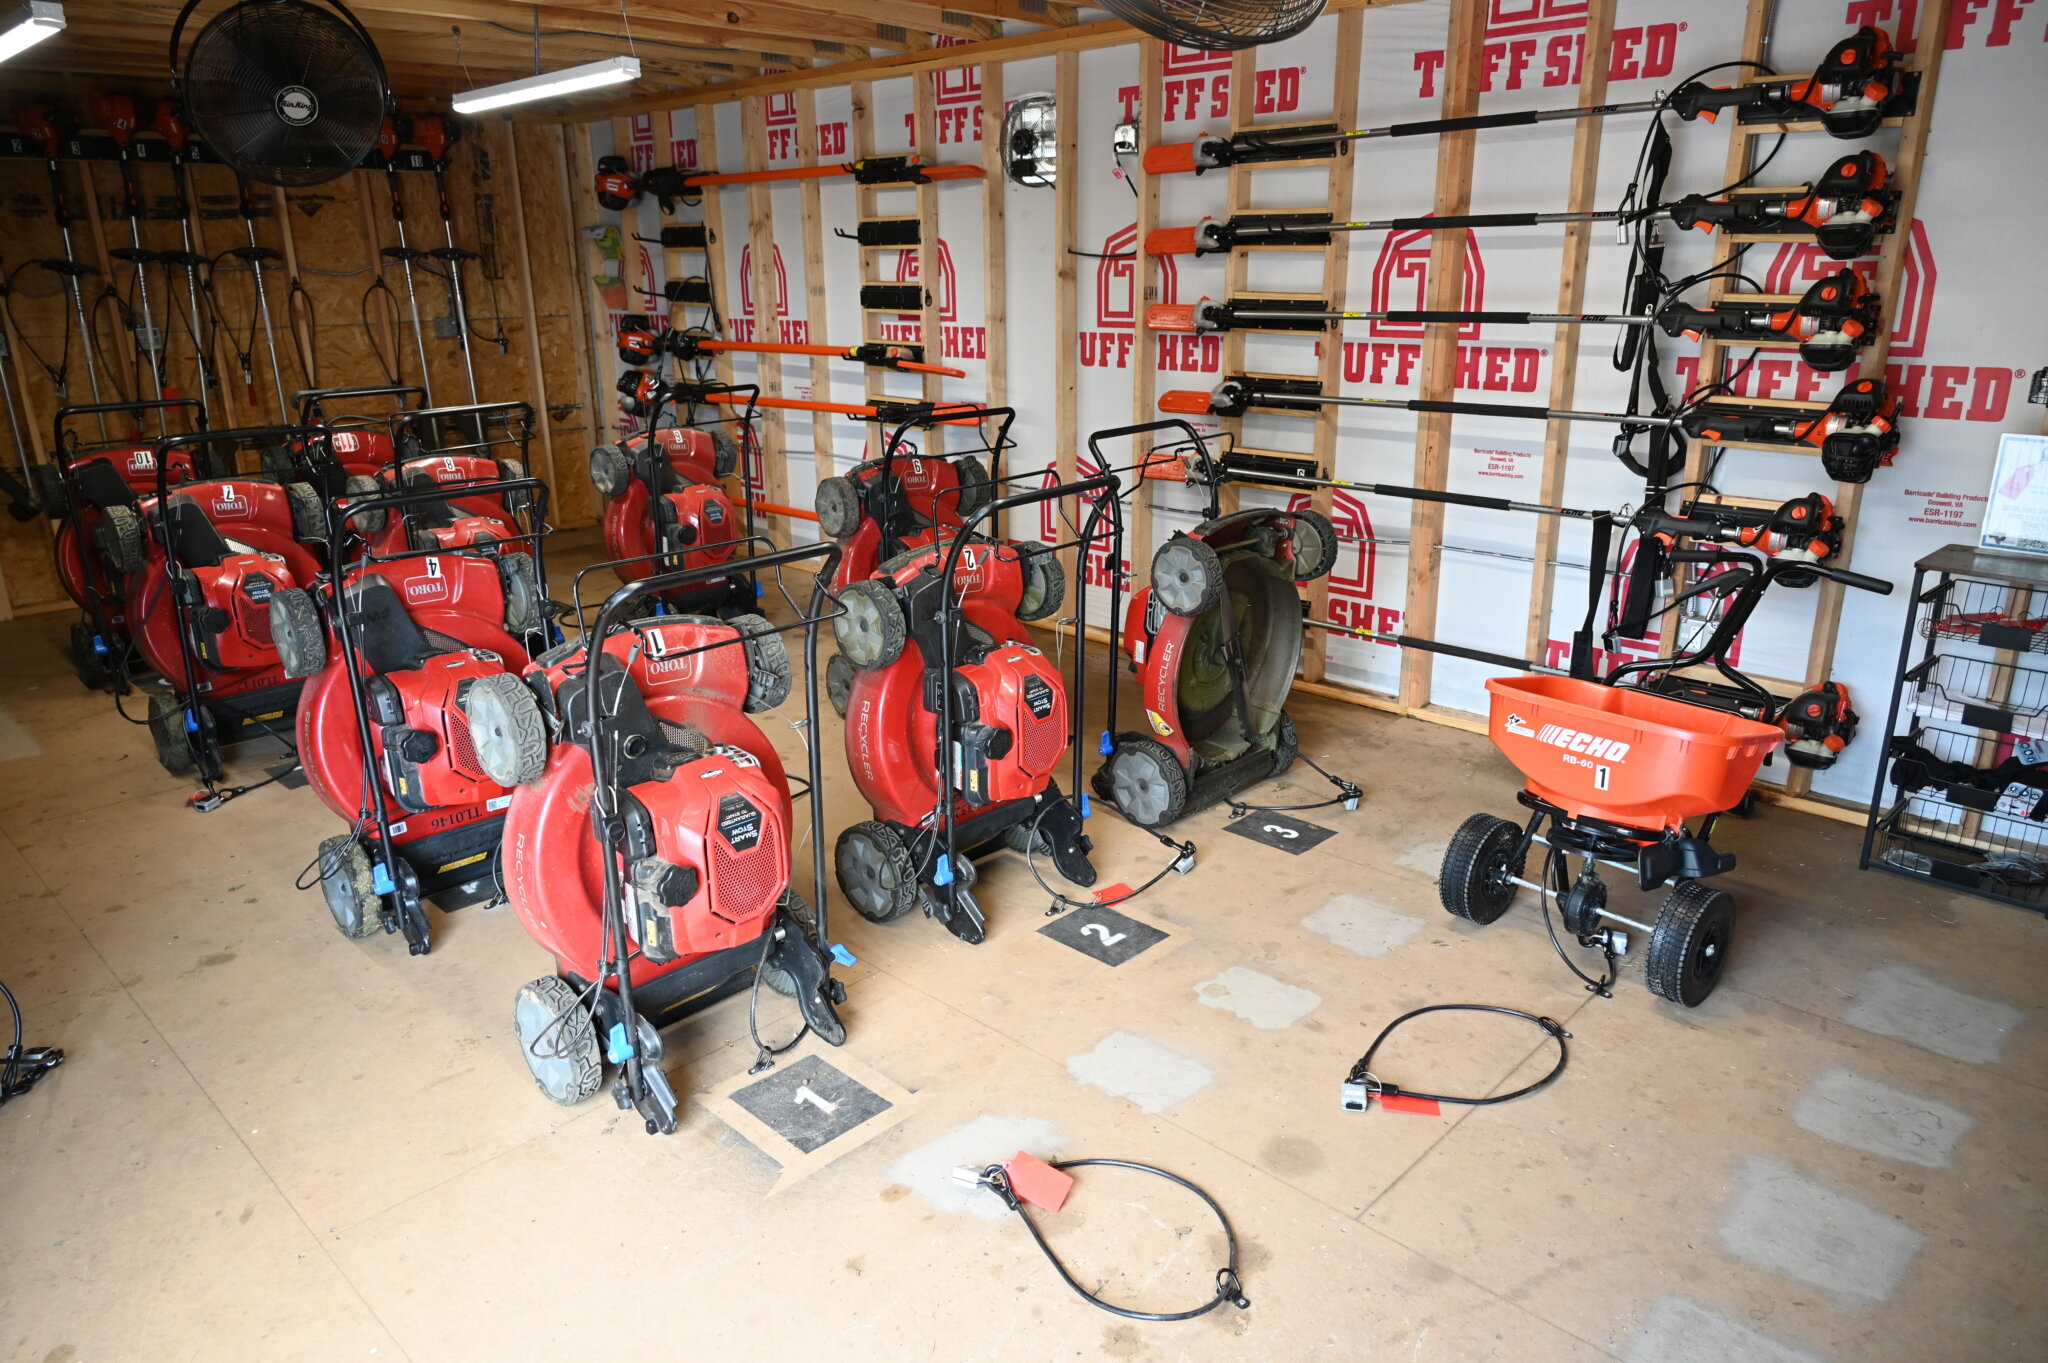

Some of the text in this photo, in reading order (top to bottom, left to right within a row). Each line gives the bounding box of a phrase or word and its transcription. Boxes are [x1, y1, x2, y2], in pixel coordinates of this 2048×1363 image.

[1414, 39, 1536, 98] TFF
[1118, 67, 1300, 122] TFF SED
[1079, 332, 1220, 373] UFF HED
[1454, 346, 1540, 393] HED
[446, 458, 453, 469] 8
[1488, 463, 1514, 471] ESR-1197
[225, 487, 233, 499] 7
[216, 502, 244, 511] TORO
[1924, 508, 1964, 518] ESR-1197
[1909, 517, 1977, 527] www.barricadebp.com
[429, 559, 437, 572] 4
[965, 551, 974, 568] 2
[409, 583, 443, 595] TORO
[1327, 598, 1405, 648] SHE
[651, 631, 663, 655] 1
[650, 657, 688, 675] TORO
[1158, 642, 1175, 712] RECYCLER
[1034, 697, 1048, 706] STOW
[1034, 702, 1051, 713] SMART
[858, 701, 874, 783] RECYCLER
[1552, 727, 1631, 763] ECHO
[1562, 753, 1594, 769] RB-60
[1599, 767, 1607, 789] 1
[431, 806, 483, 830] TL0146
[721, 811, 757, 827] GUARANTEED
[731, 823, 754, 836] STOW
[731, 829, 758, 844] SMART
[1263, 823, 1299, 839] 3
[515, 832, 540, 930] RECYCLER
[1080, 923, 1128, 947] 2
[793, 1085, 837, 1114] 1
